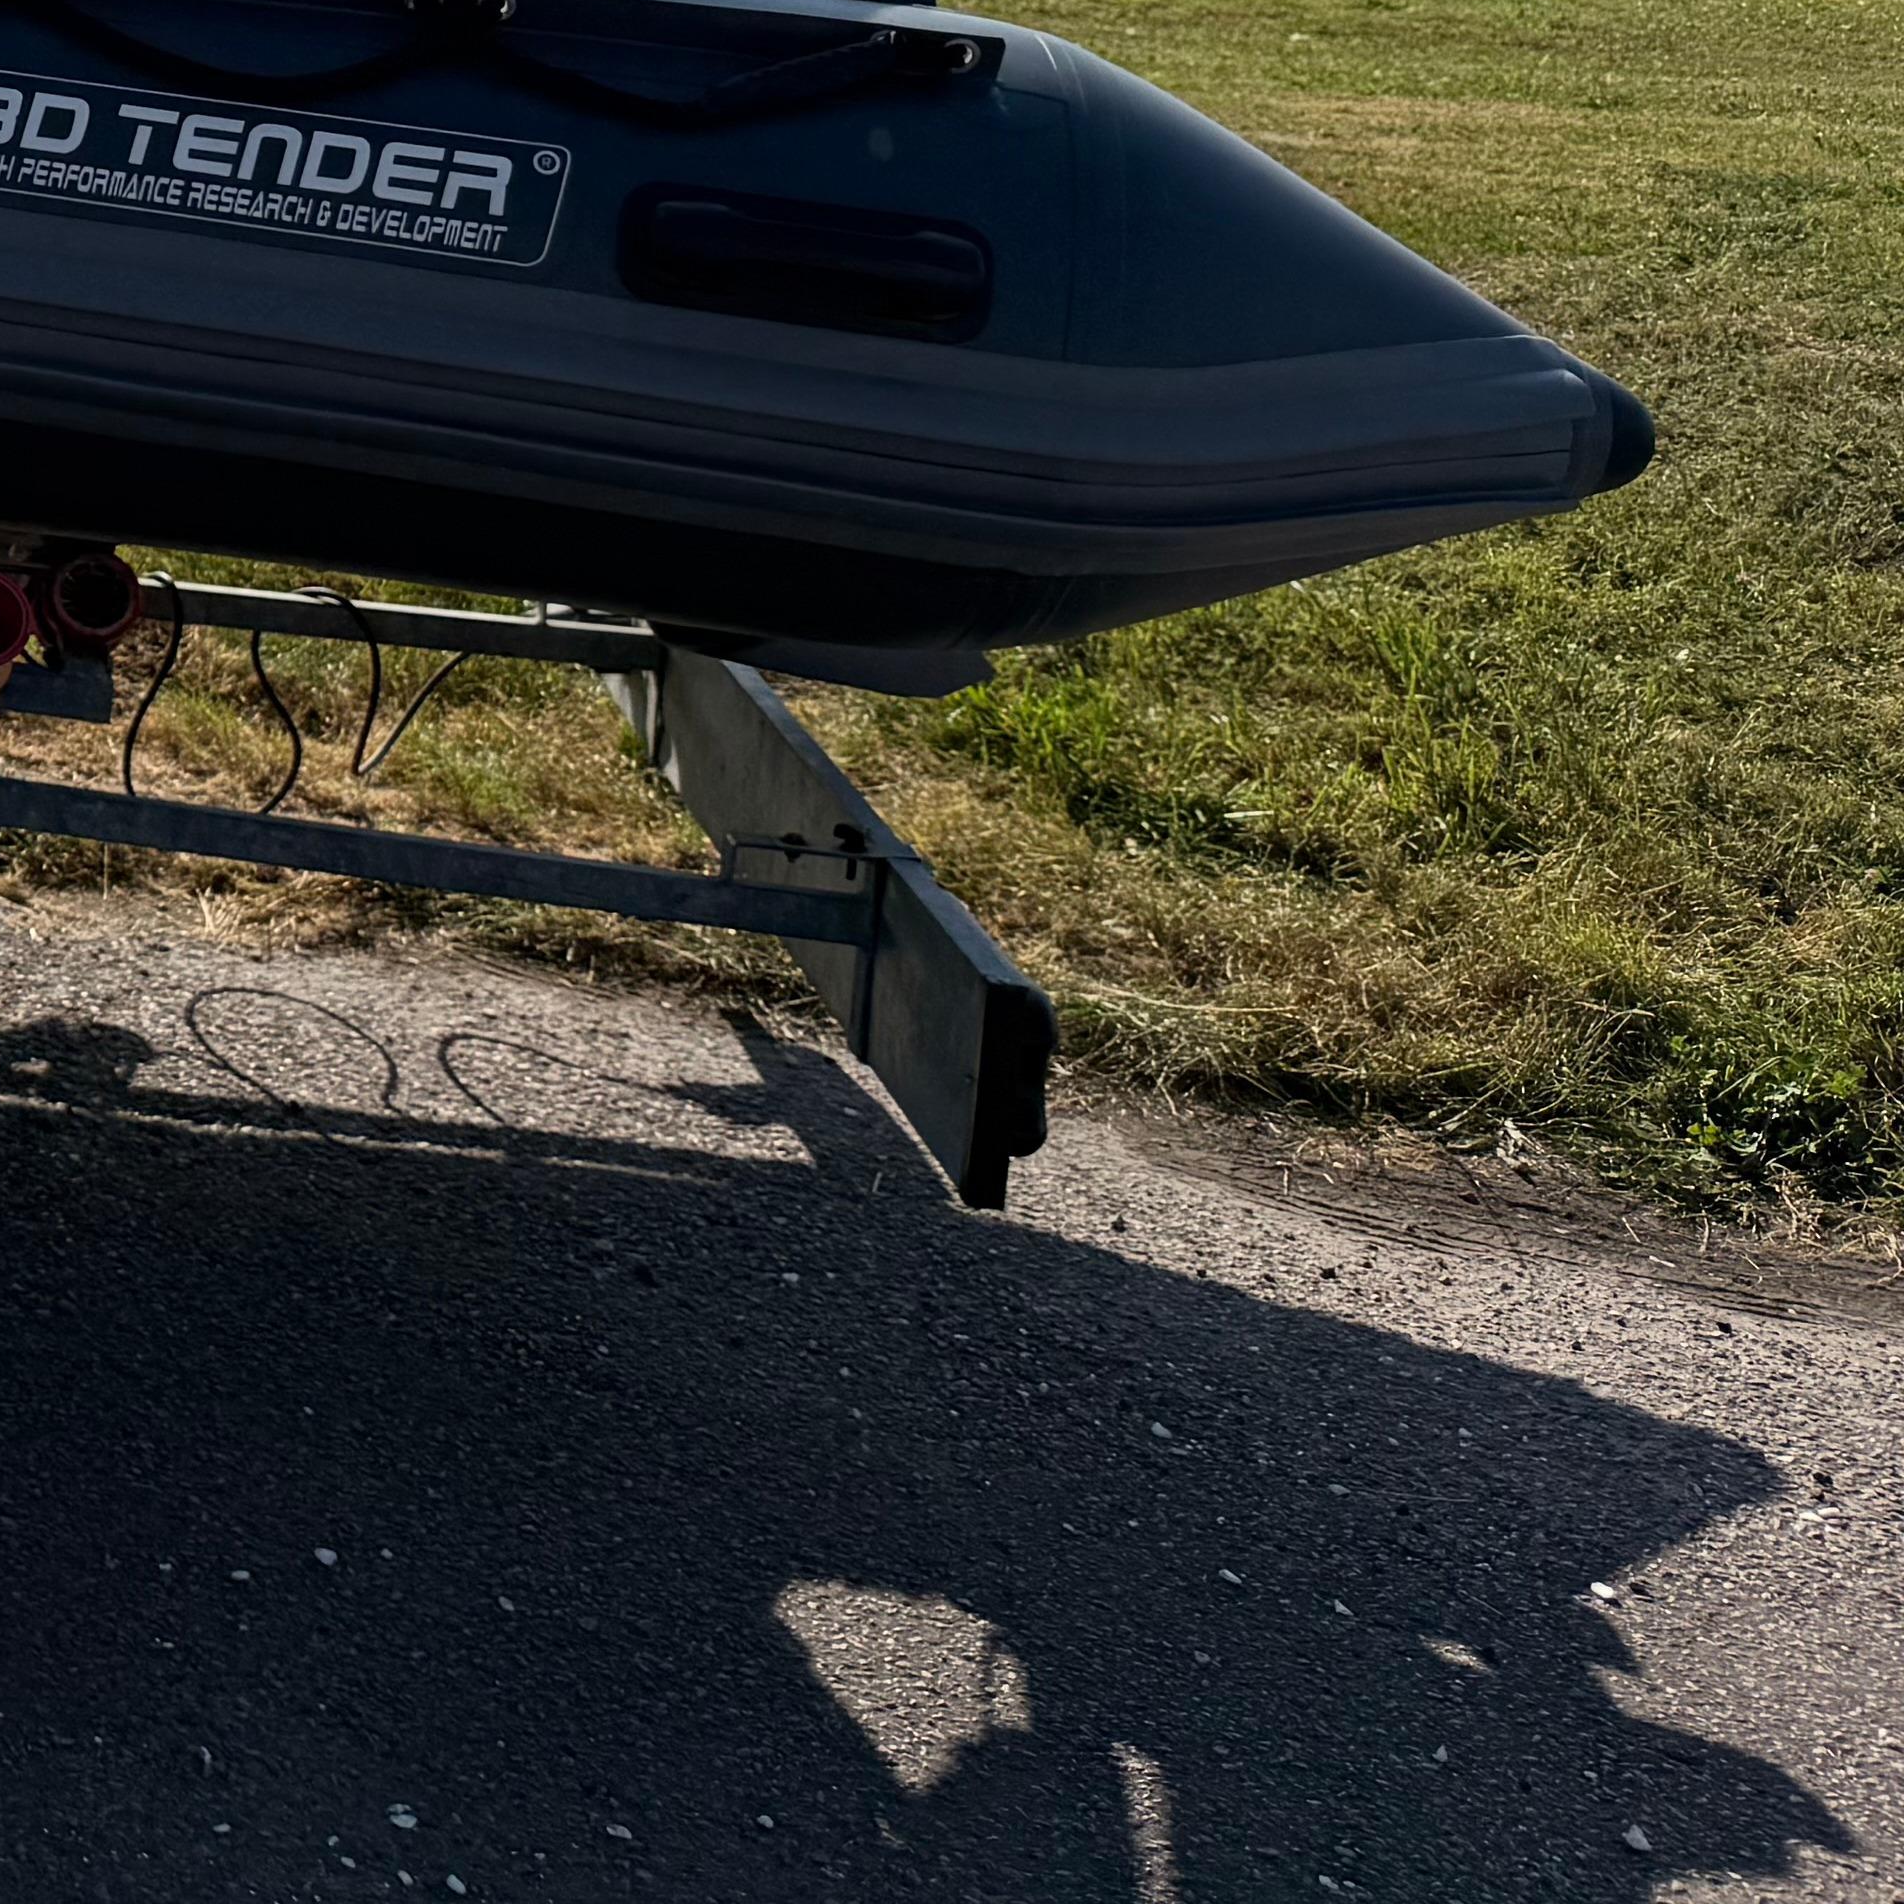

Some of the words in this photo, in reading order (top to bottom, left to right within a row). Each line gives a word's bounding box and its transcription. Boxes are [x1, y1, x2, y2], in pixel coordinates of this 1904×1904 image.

[17, 156, 184, 207] PERFORMANCE
[187, 189, 313, 226] RESEARCH
[316, 200, 332, 227] &
[335, 202, 508, 253] DEVELOPMENT
[117, 102, 514, 216] TENDER
